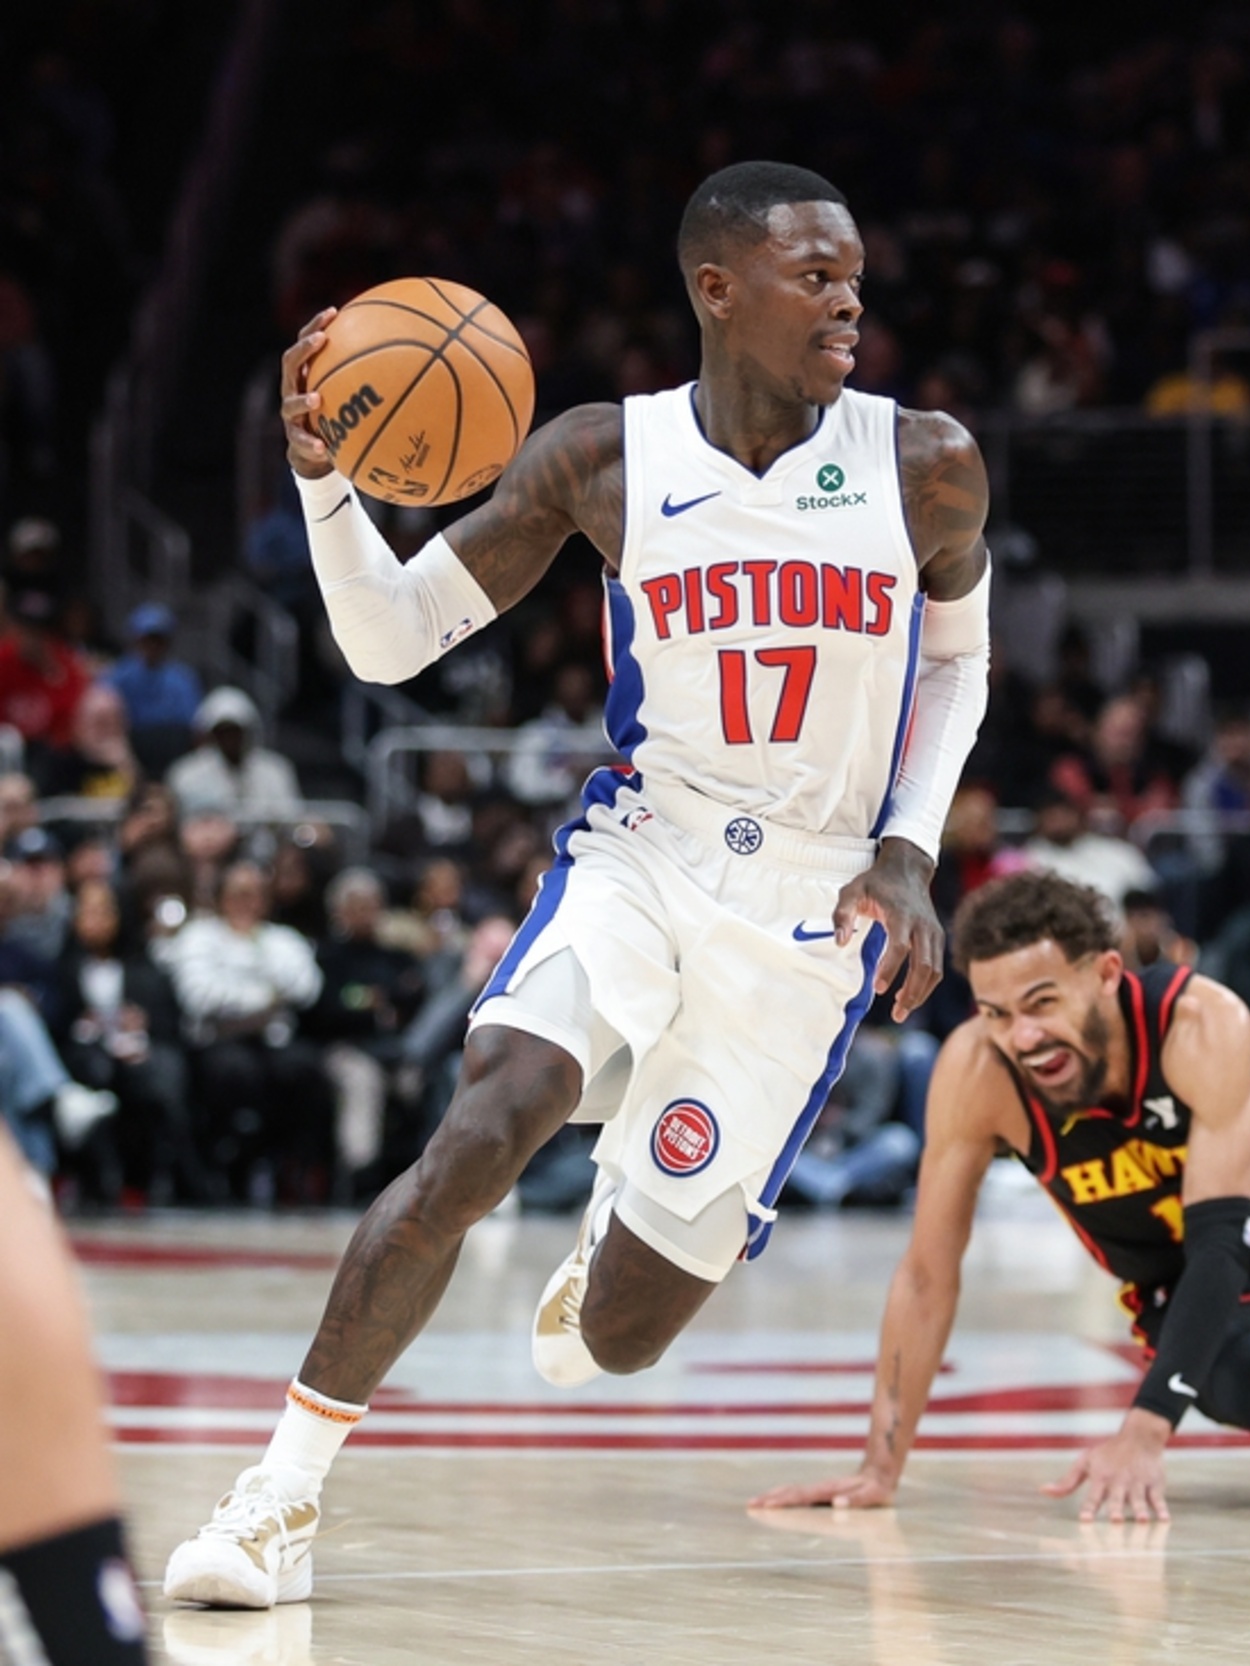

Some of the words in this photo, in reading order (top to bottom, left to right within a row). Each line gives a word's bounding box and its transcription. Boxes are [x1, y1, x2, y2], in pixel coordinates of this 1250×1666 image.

[317, 384, 384, 457] lson
[796, 491, 867, 511] StockX
[641, 560, 897, 640] PISTONS
[718, 645, 817, 744] 17
[1061, 1138, 1188, 1205] HAW
